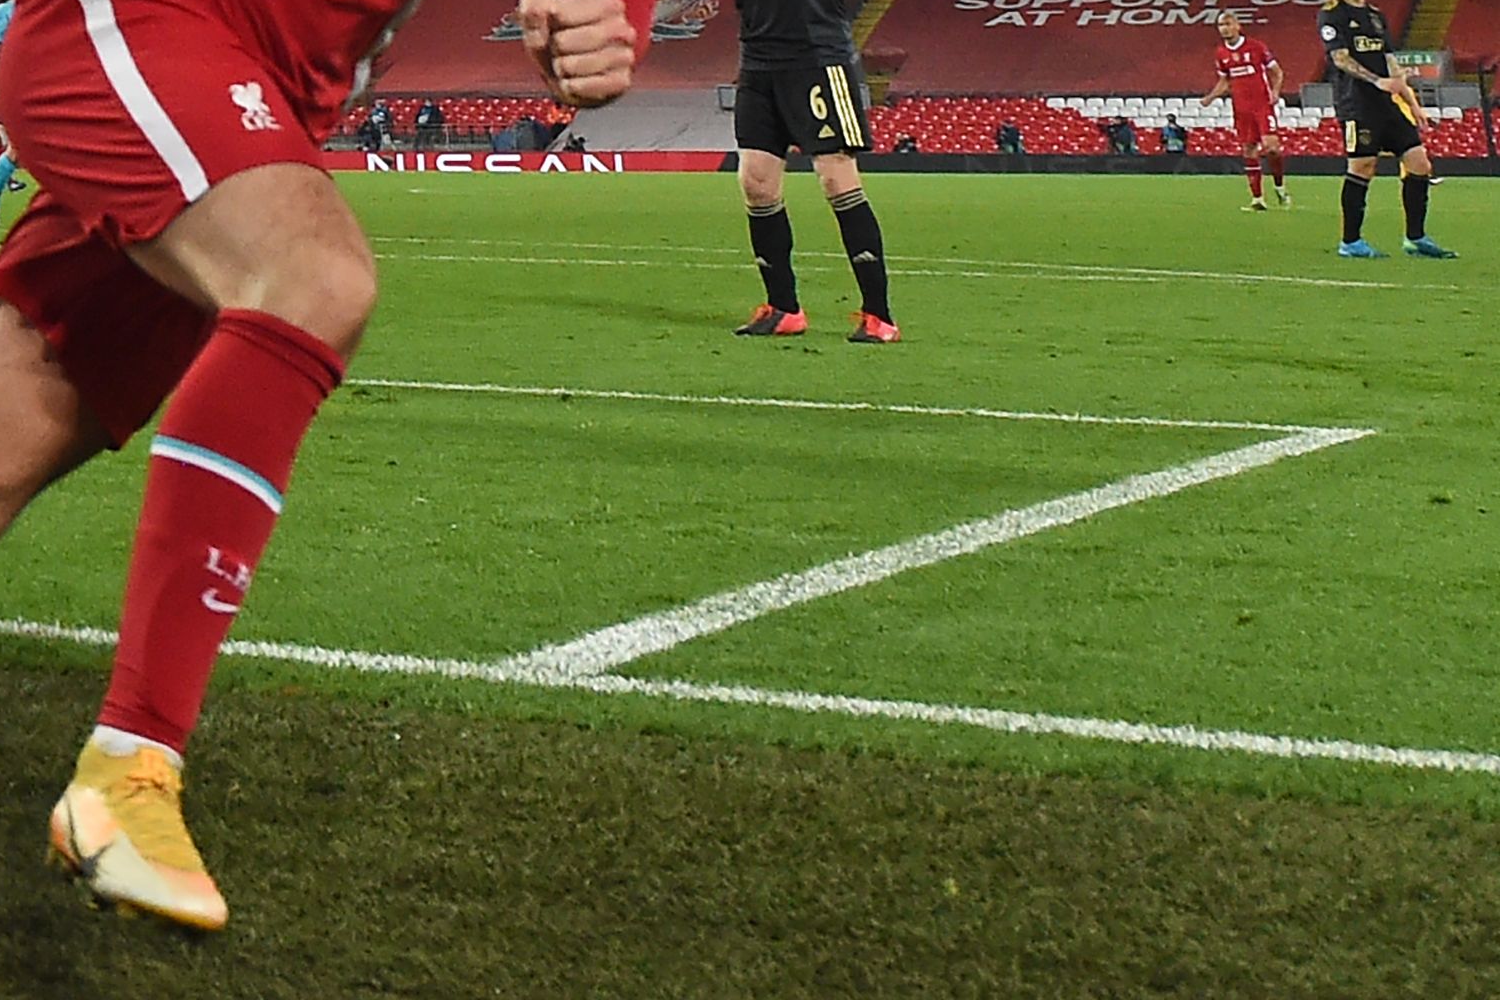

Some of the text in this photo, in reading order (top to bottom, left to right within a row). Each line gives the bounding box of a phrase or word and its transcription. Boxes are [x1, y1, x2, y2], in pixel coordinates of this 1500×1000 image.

[983, 10, 1066, 28] AT
[809, 84, 828, 120] 6
[367, 153, 623, 172] NISSAN
